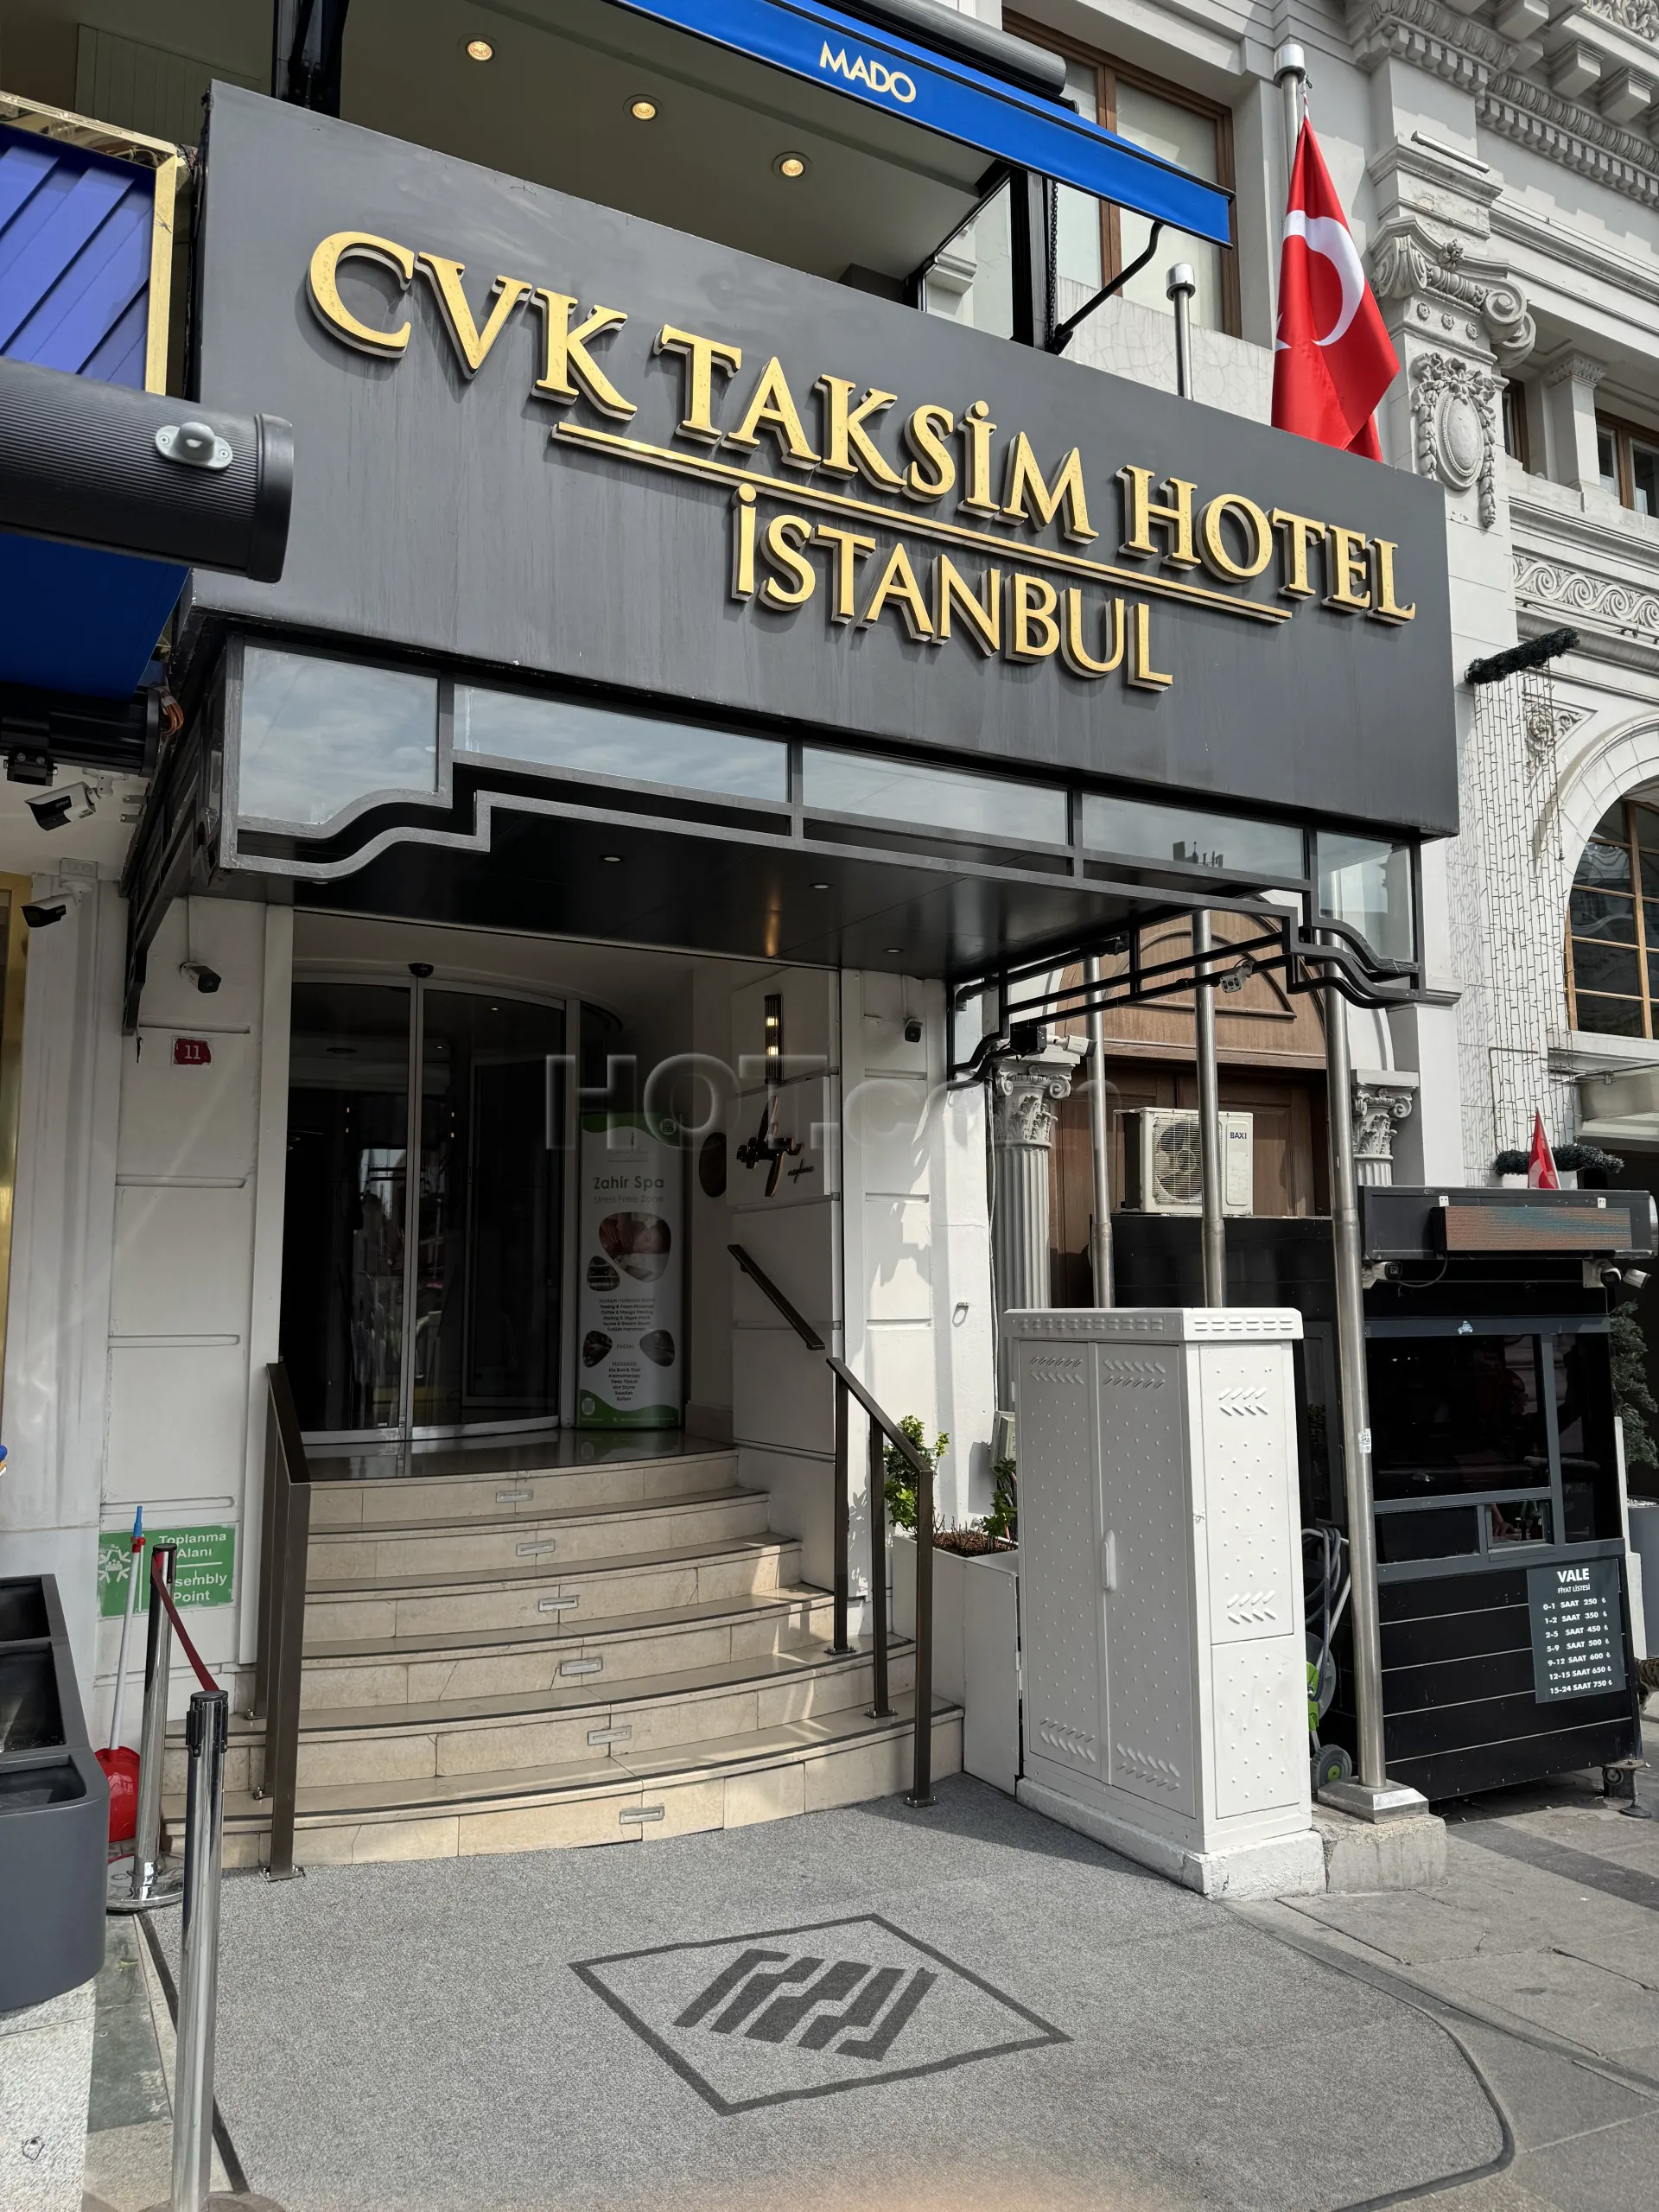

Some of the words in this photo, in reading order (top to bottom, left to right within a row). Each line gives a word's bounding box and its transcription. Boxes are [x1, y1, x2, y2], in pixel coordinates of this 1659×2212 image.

[820, 41, 917, 103] MADO
[306, 231, 638, 421] CVK
[653, 323, 1100, 545] TAKSİM
[1116, 464, 1417, 626] HOTEL
[730, 483, 1174, 692] İSTANBUL
[184, 1045, 201, 1059] 11
[593, 1176, 629, 1189] Zahir
[634, 1176, 664, 1191] Spa
[594, 1195, 616, 1204] Stress
[640, 1194, 664, 1203] Zone
[159, 1534, 226, 1545] Toplanma
[177, 1548, 212, 1559] Alanı
[175, 1573, 227, 1587] sembly
[1557, 1568, 1590, 1583] VALE
[174, 1591, 211, 1602] Point
[1572, 1669, 1590, 1677] SAAT
[1573, 1682, 1592, 1691] SAAT
